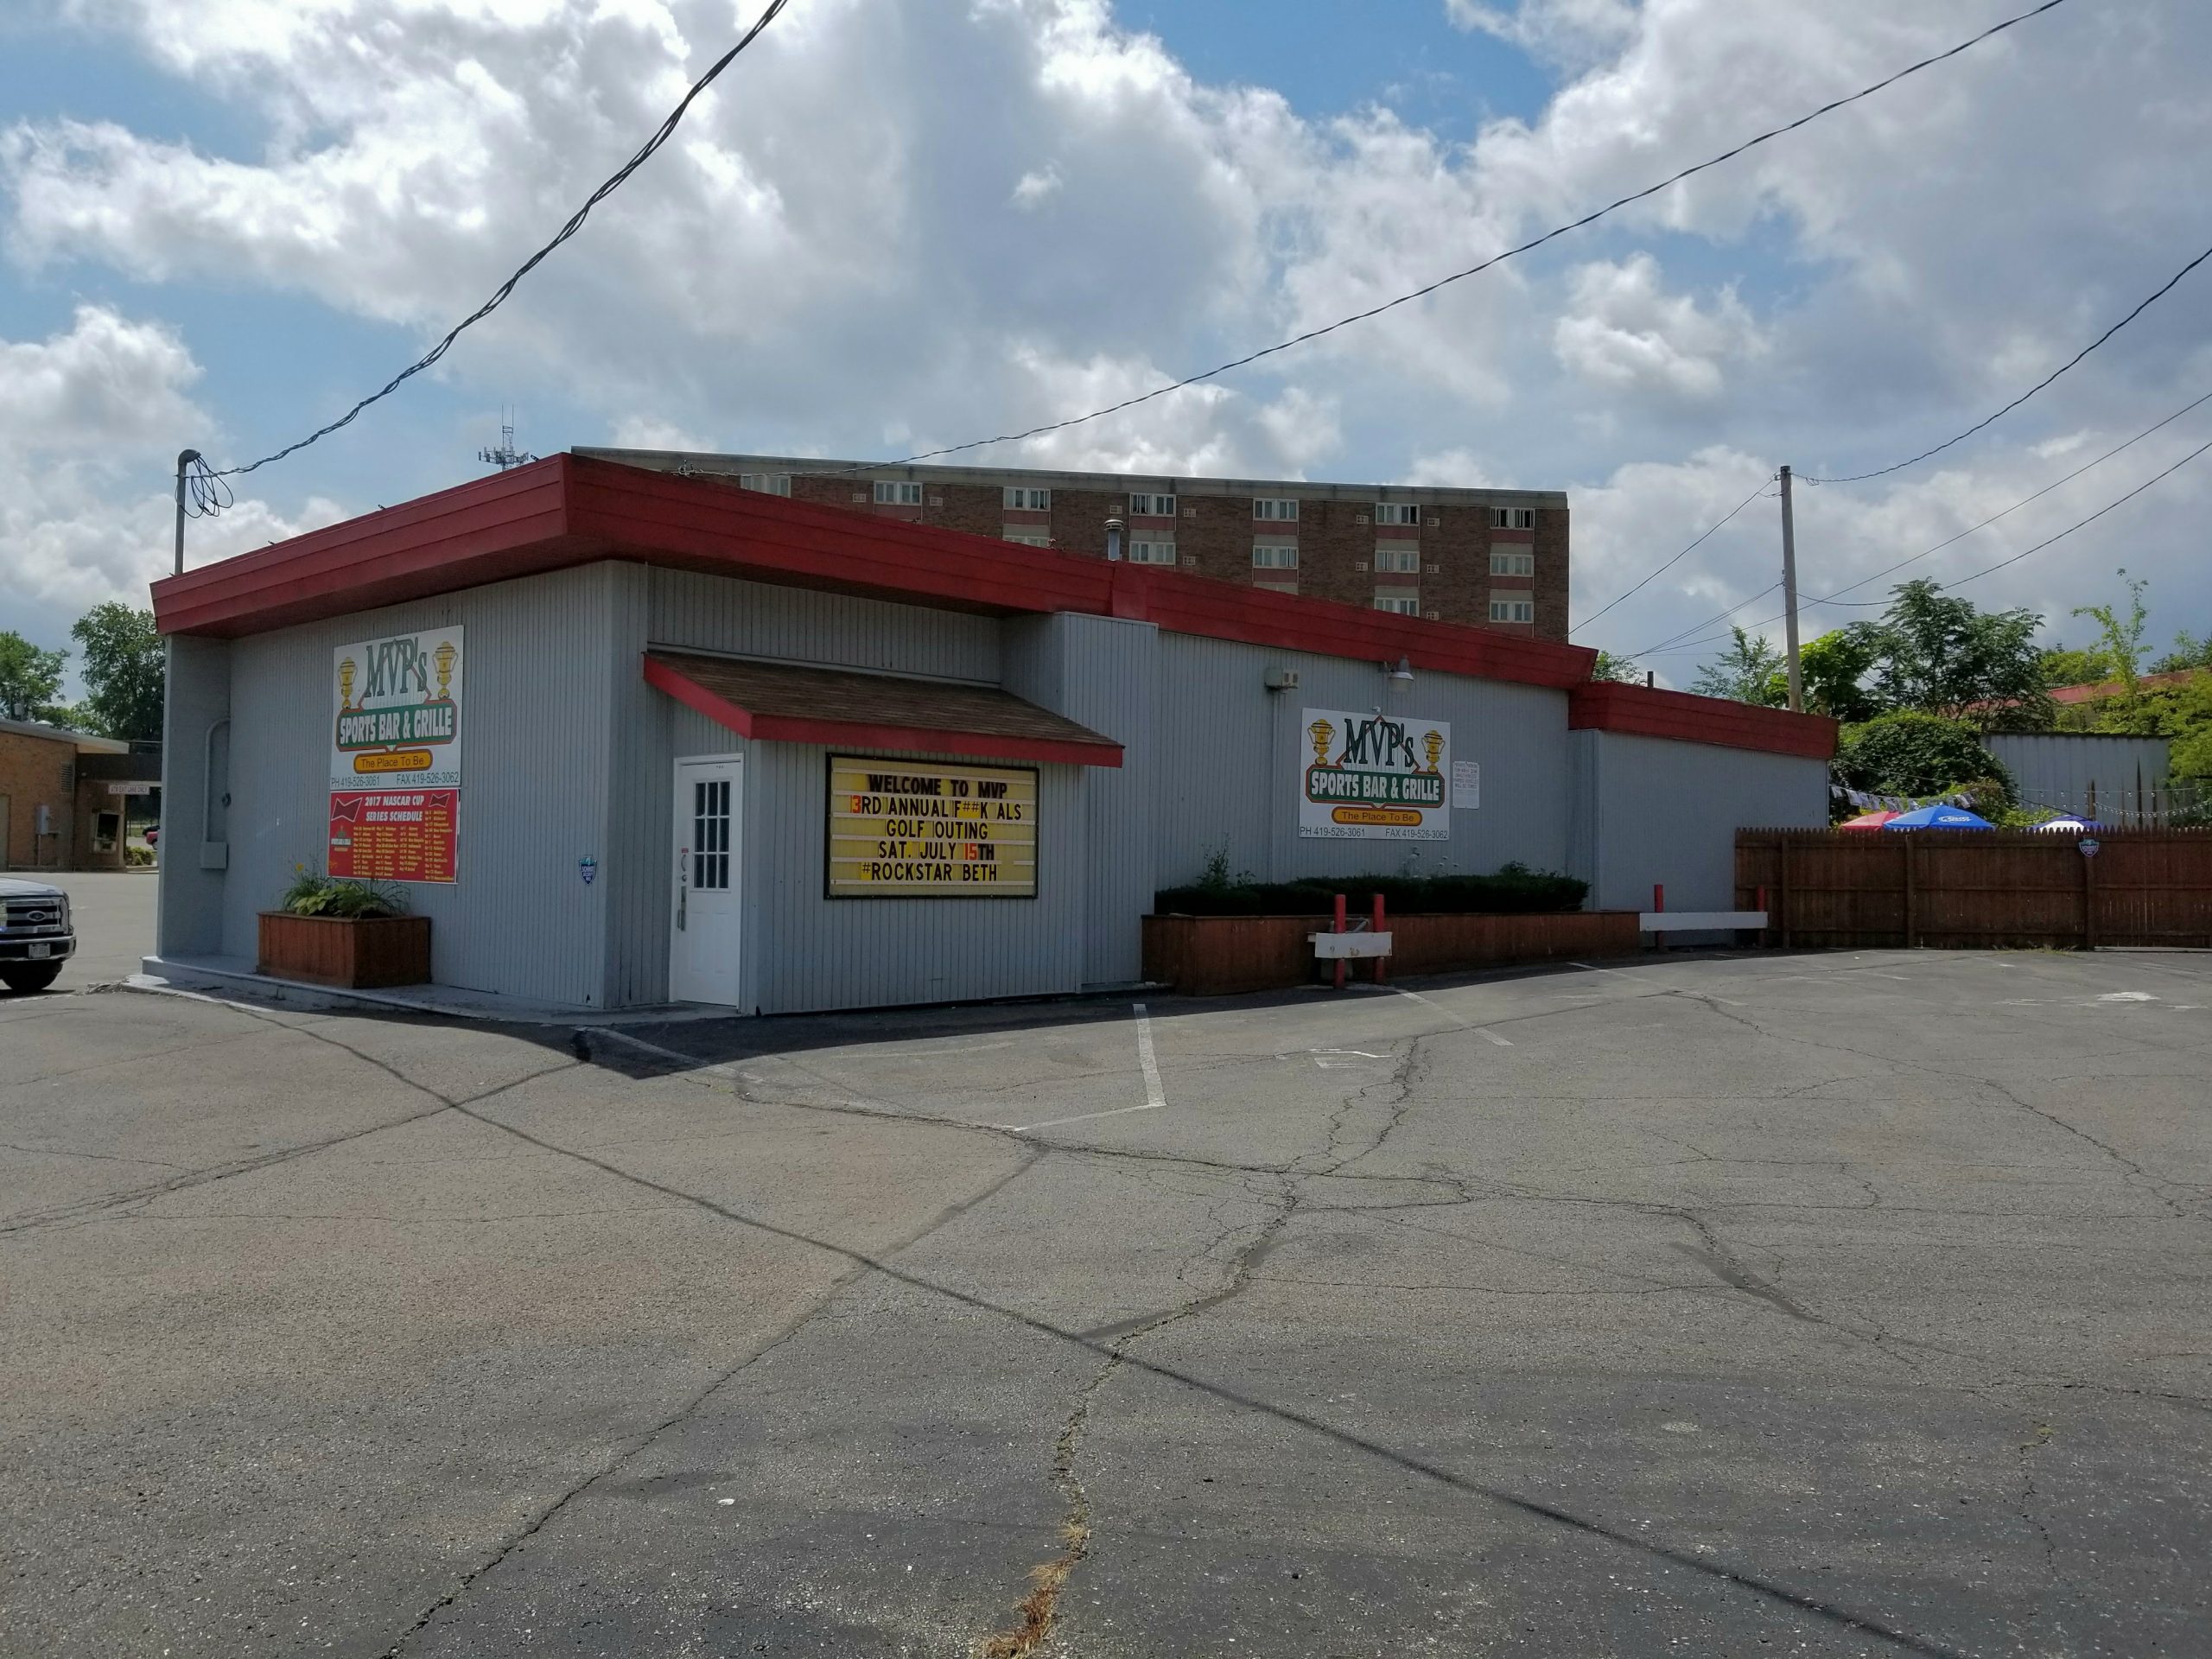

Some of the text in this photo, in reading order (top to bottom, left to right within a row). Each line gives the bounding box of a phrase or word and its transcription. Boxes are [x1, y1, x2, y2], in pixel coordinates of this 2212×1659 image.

[364, 637, 428, 697] MVP's
[340, 707, 452, 745] SPORTS BAR & GRILLE
[1344, 718, 1414, 767] MVP's
[362, 755, 423, 768] The Place To Be
[397, 772, 459, 785] FAX 419-526-3062
[868, 775, 1007, 798] WELCOME TO MVP
[1311, 772, 1440, 801] SPORTS BAR & GRILLE
[365, 795, 424, 806] 2017 NASCAR CUP
[852, 796, 881, 815] 3RD
[888, 797, 949, 817] ANNUAL
[997, 803, 1021, 820] ALS
[365, 810, 423, 822] SERIES SCHEDULE
[1342, 811, 1359, 820] The
[1362, 812, 1387, 821] Place
[1389, 813, 1400, 822] To
[887, 819, 988, 840] GOLF OUTING
[1300, 827, 1365, 836] PH 419-526-3061
[1385, 829, 1448, 839] FAX 419-526-3062
[879, 841, 994, 861] SAT. JULY 15TH
[861, 862, 997, 881] #ROCKSTAR BETH
